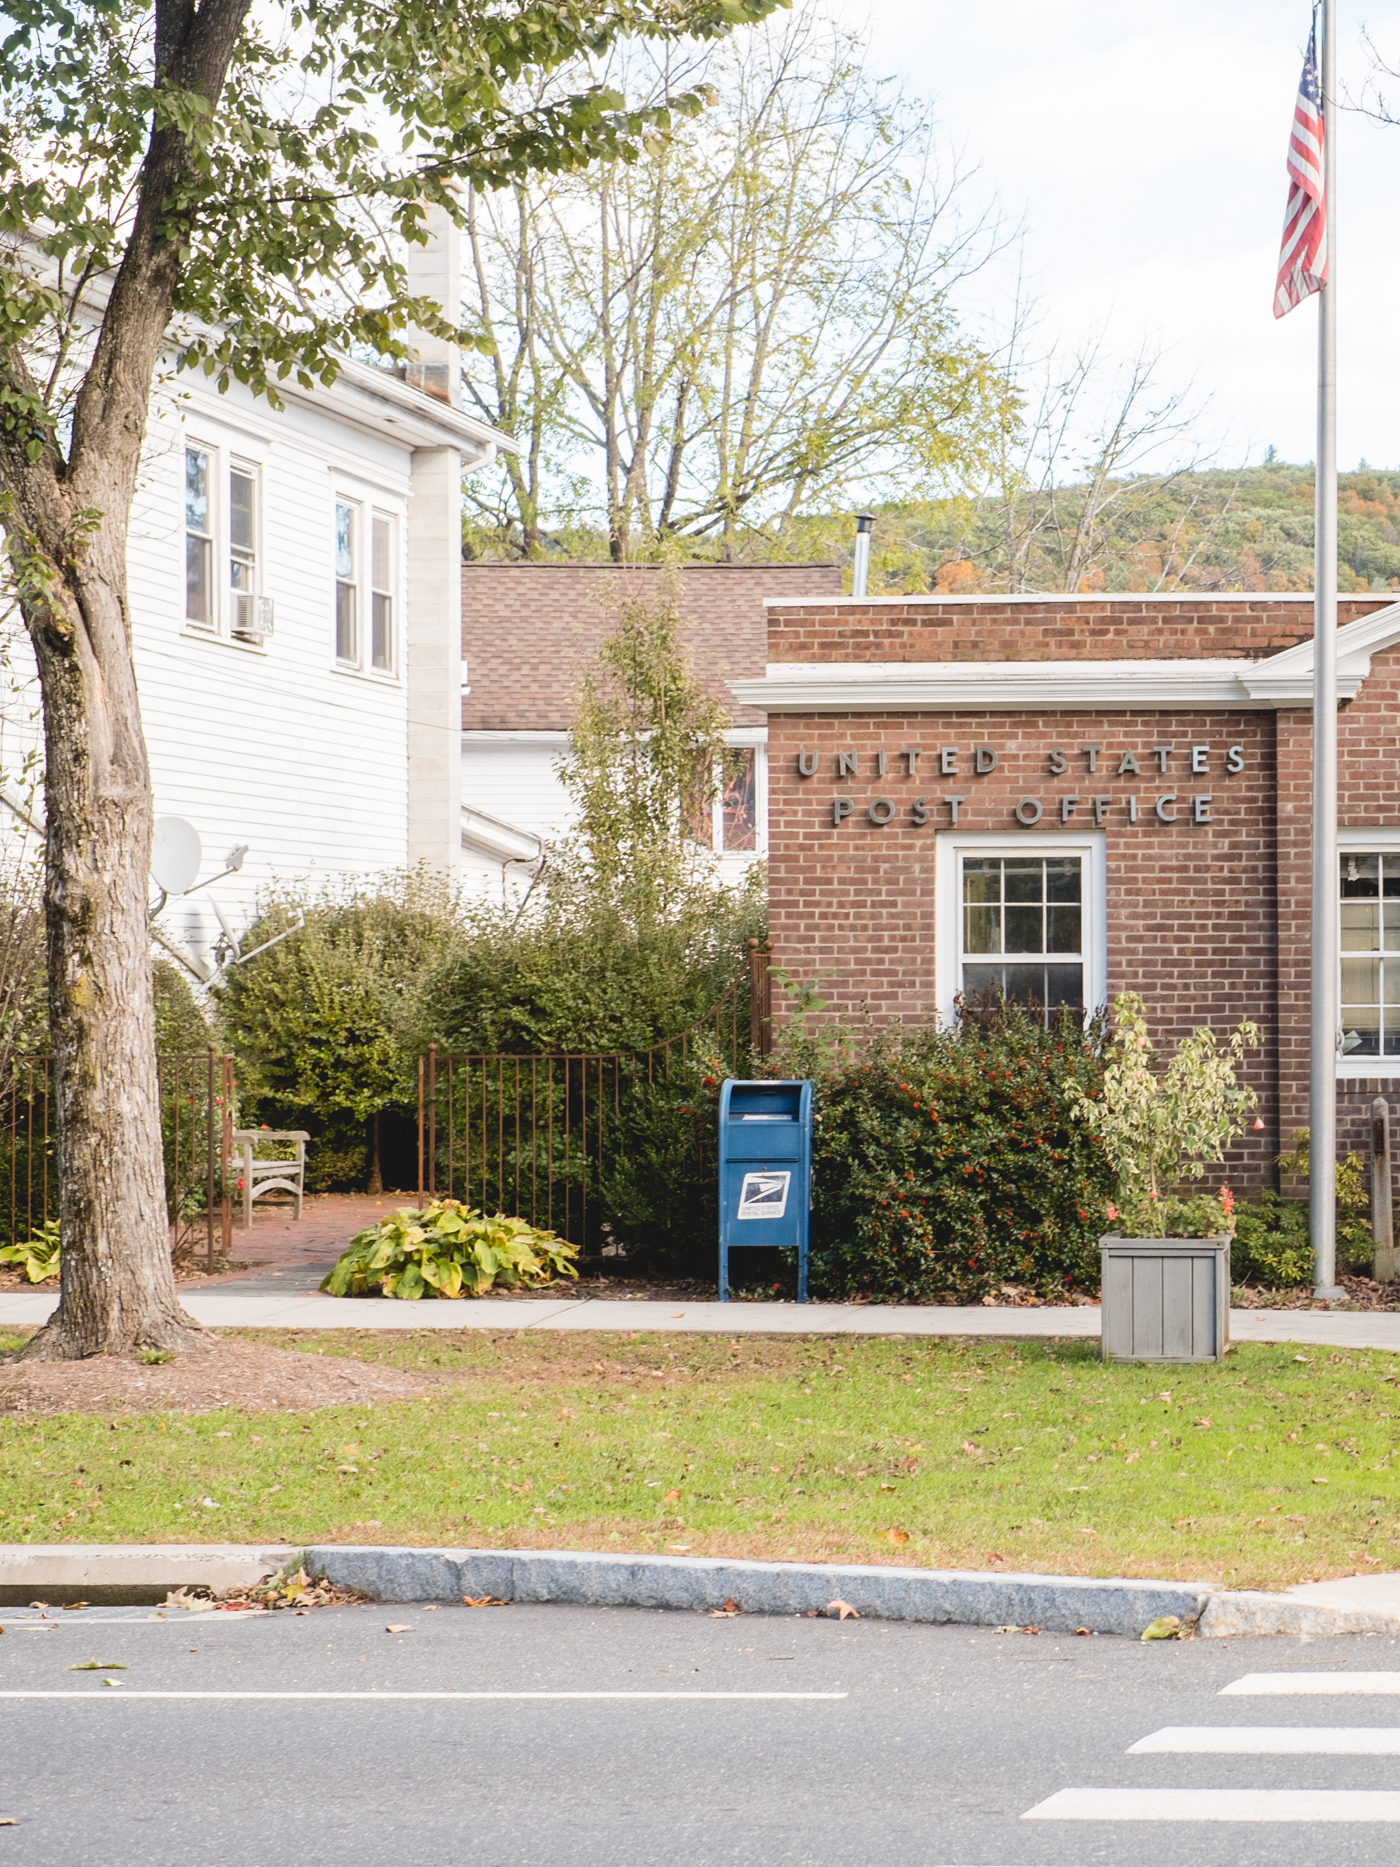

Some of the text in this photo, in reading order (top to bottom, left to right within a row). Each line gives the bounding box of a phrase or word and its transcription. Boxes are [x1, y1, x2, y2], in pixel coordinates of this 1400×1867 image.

[799, 745, 1245, 776] UNITED STATES
[833, 795, 1213, 825] POST OFFICE
